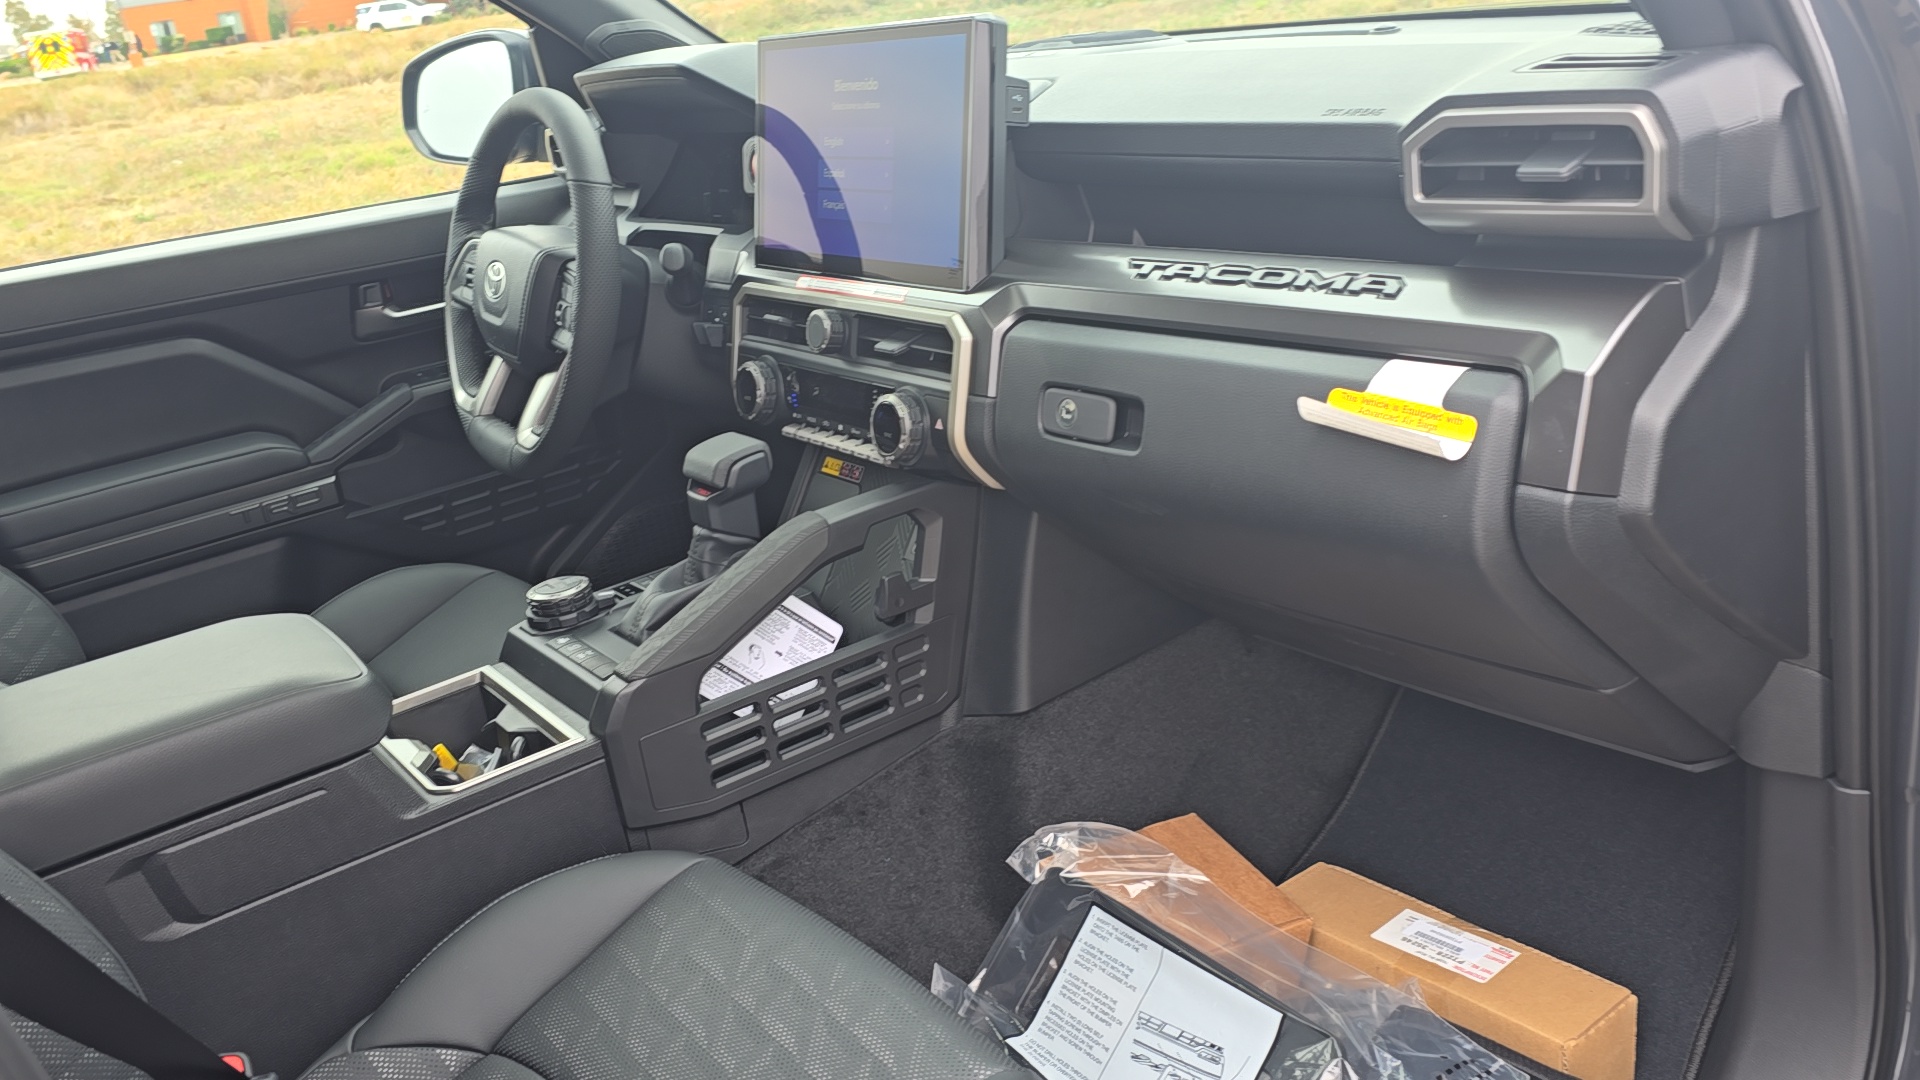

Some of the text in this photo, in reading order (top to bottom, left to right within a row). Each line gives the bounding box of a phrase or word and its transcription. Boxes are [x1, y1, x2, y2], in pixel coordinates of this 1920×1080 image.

[834, 77, 879, 92] Bienvenido
[1128, 258, 1407, 300] TACOMA
[1096, 948, 1105, 956] THE
[1103, 953, 1119, 964] HOLES
[1125, 965, 1134, 974] THE
[1077, 953, 1092, 964] HOLES
[1098, 965, 1107, 973] THE
[1105, 970, 1124, 984] LICENSE
[1122, 981, 1137, 992] PLATE
[1120, 971, 1130, 979] THE
[1080, 979, 1089, 987] THE
[1088, 985, 1103, 996] HOLES
[1109, 997, 1118, 1006] THE
[1058, 990, 1067, 999] THE
[1086, 1008, 1095, 1017] THE
[1090, 1002, 1099, 1011] THE
[1085, 1042, 1094, 1051] THE
[1101, 1044, 1110, 1053] THE
